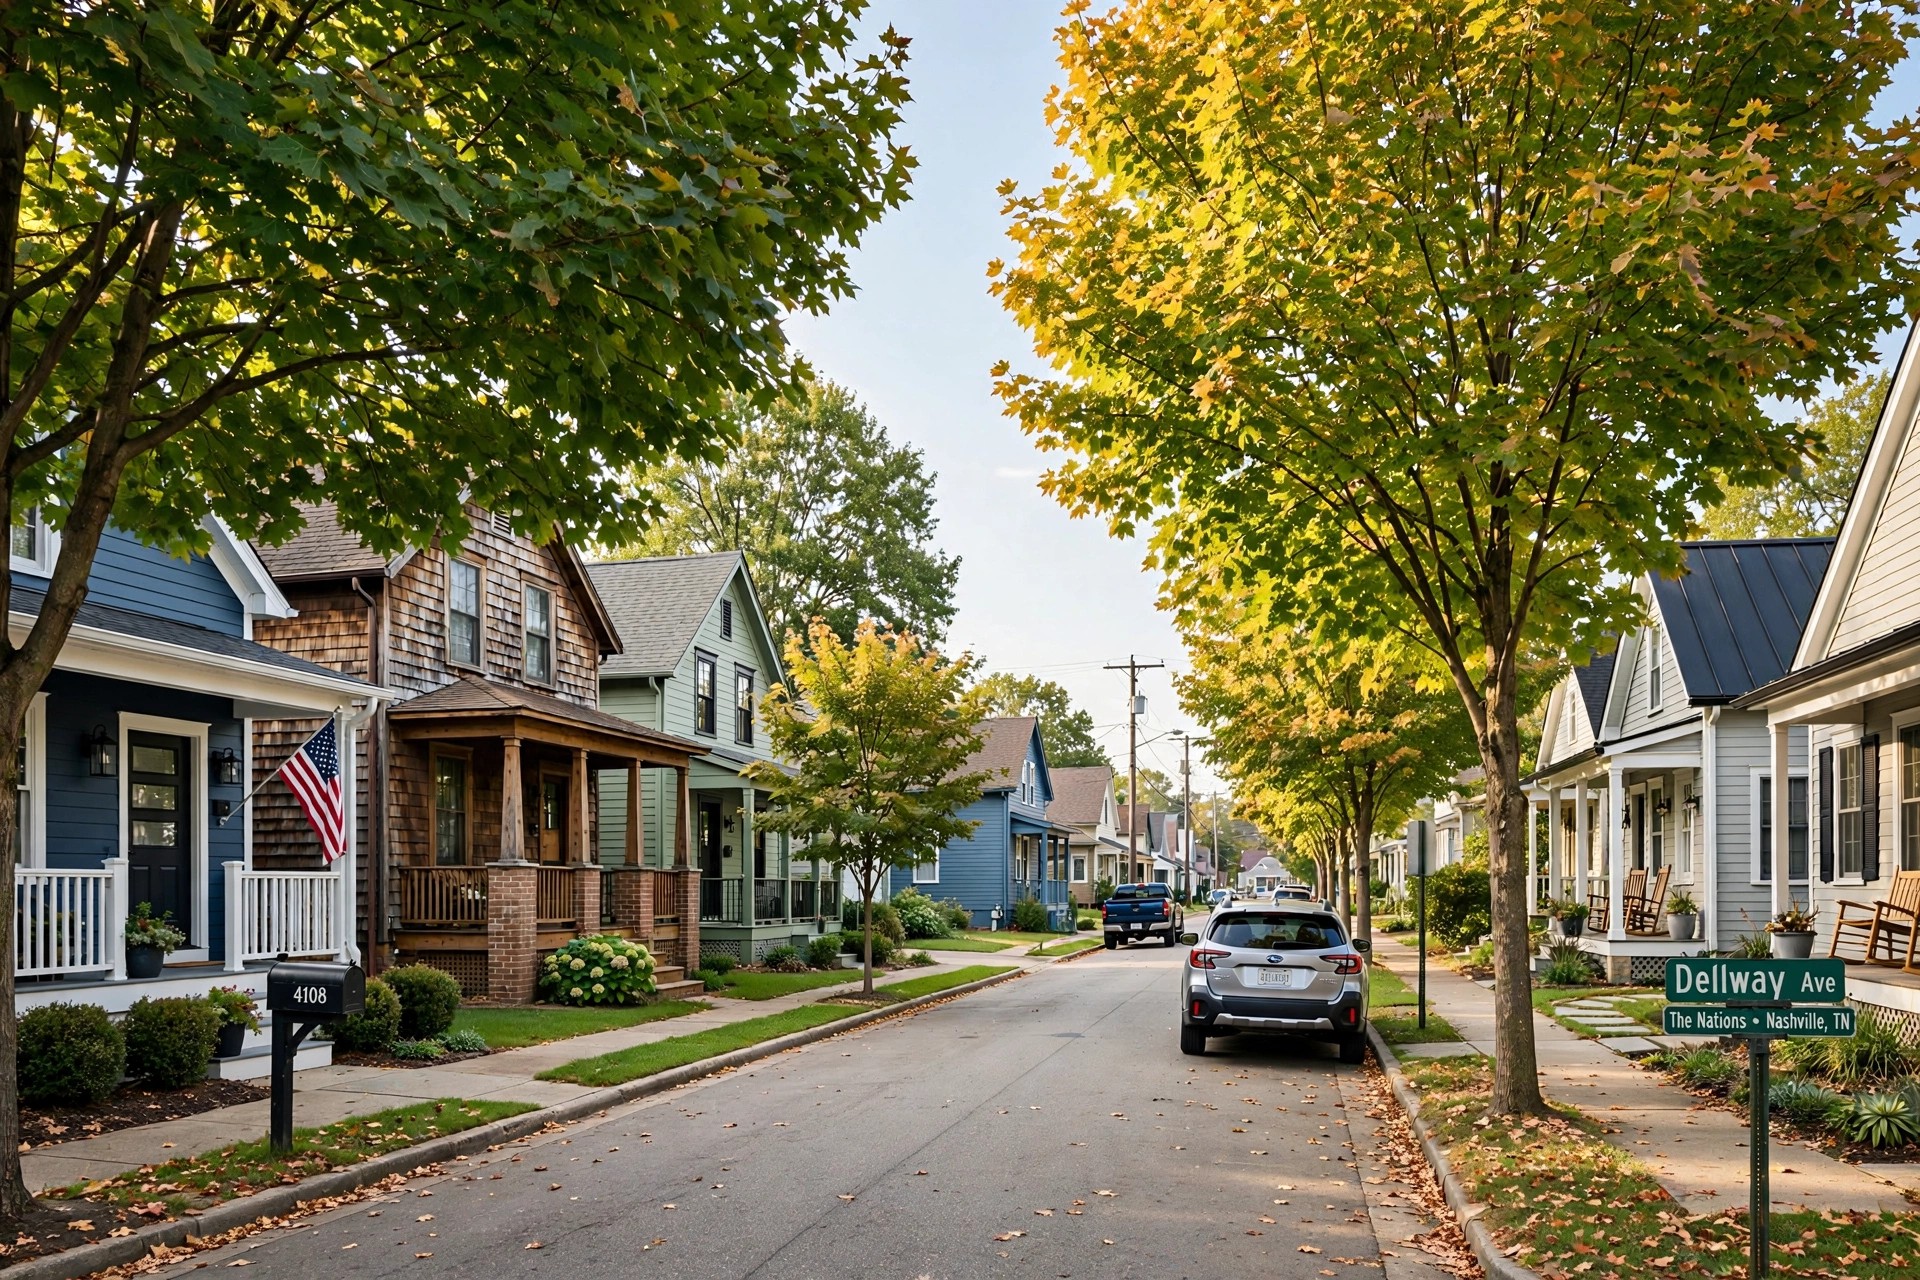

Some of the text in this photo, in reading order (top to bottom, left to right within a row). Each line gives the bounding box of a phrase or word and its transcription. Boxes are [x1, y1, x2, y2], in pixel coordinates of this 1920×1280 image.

[1675, 963, 1836, 1001] Dellway Ave
[293, 986, 327, 1004] 4108
[1669, 1011, 1850, 1033] The Nations Nashville, TN
